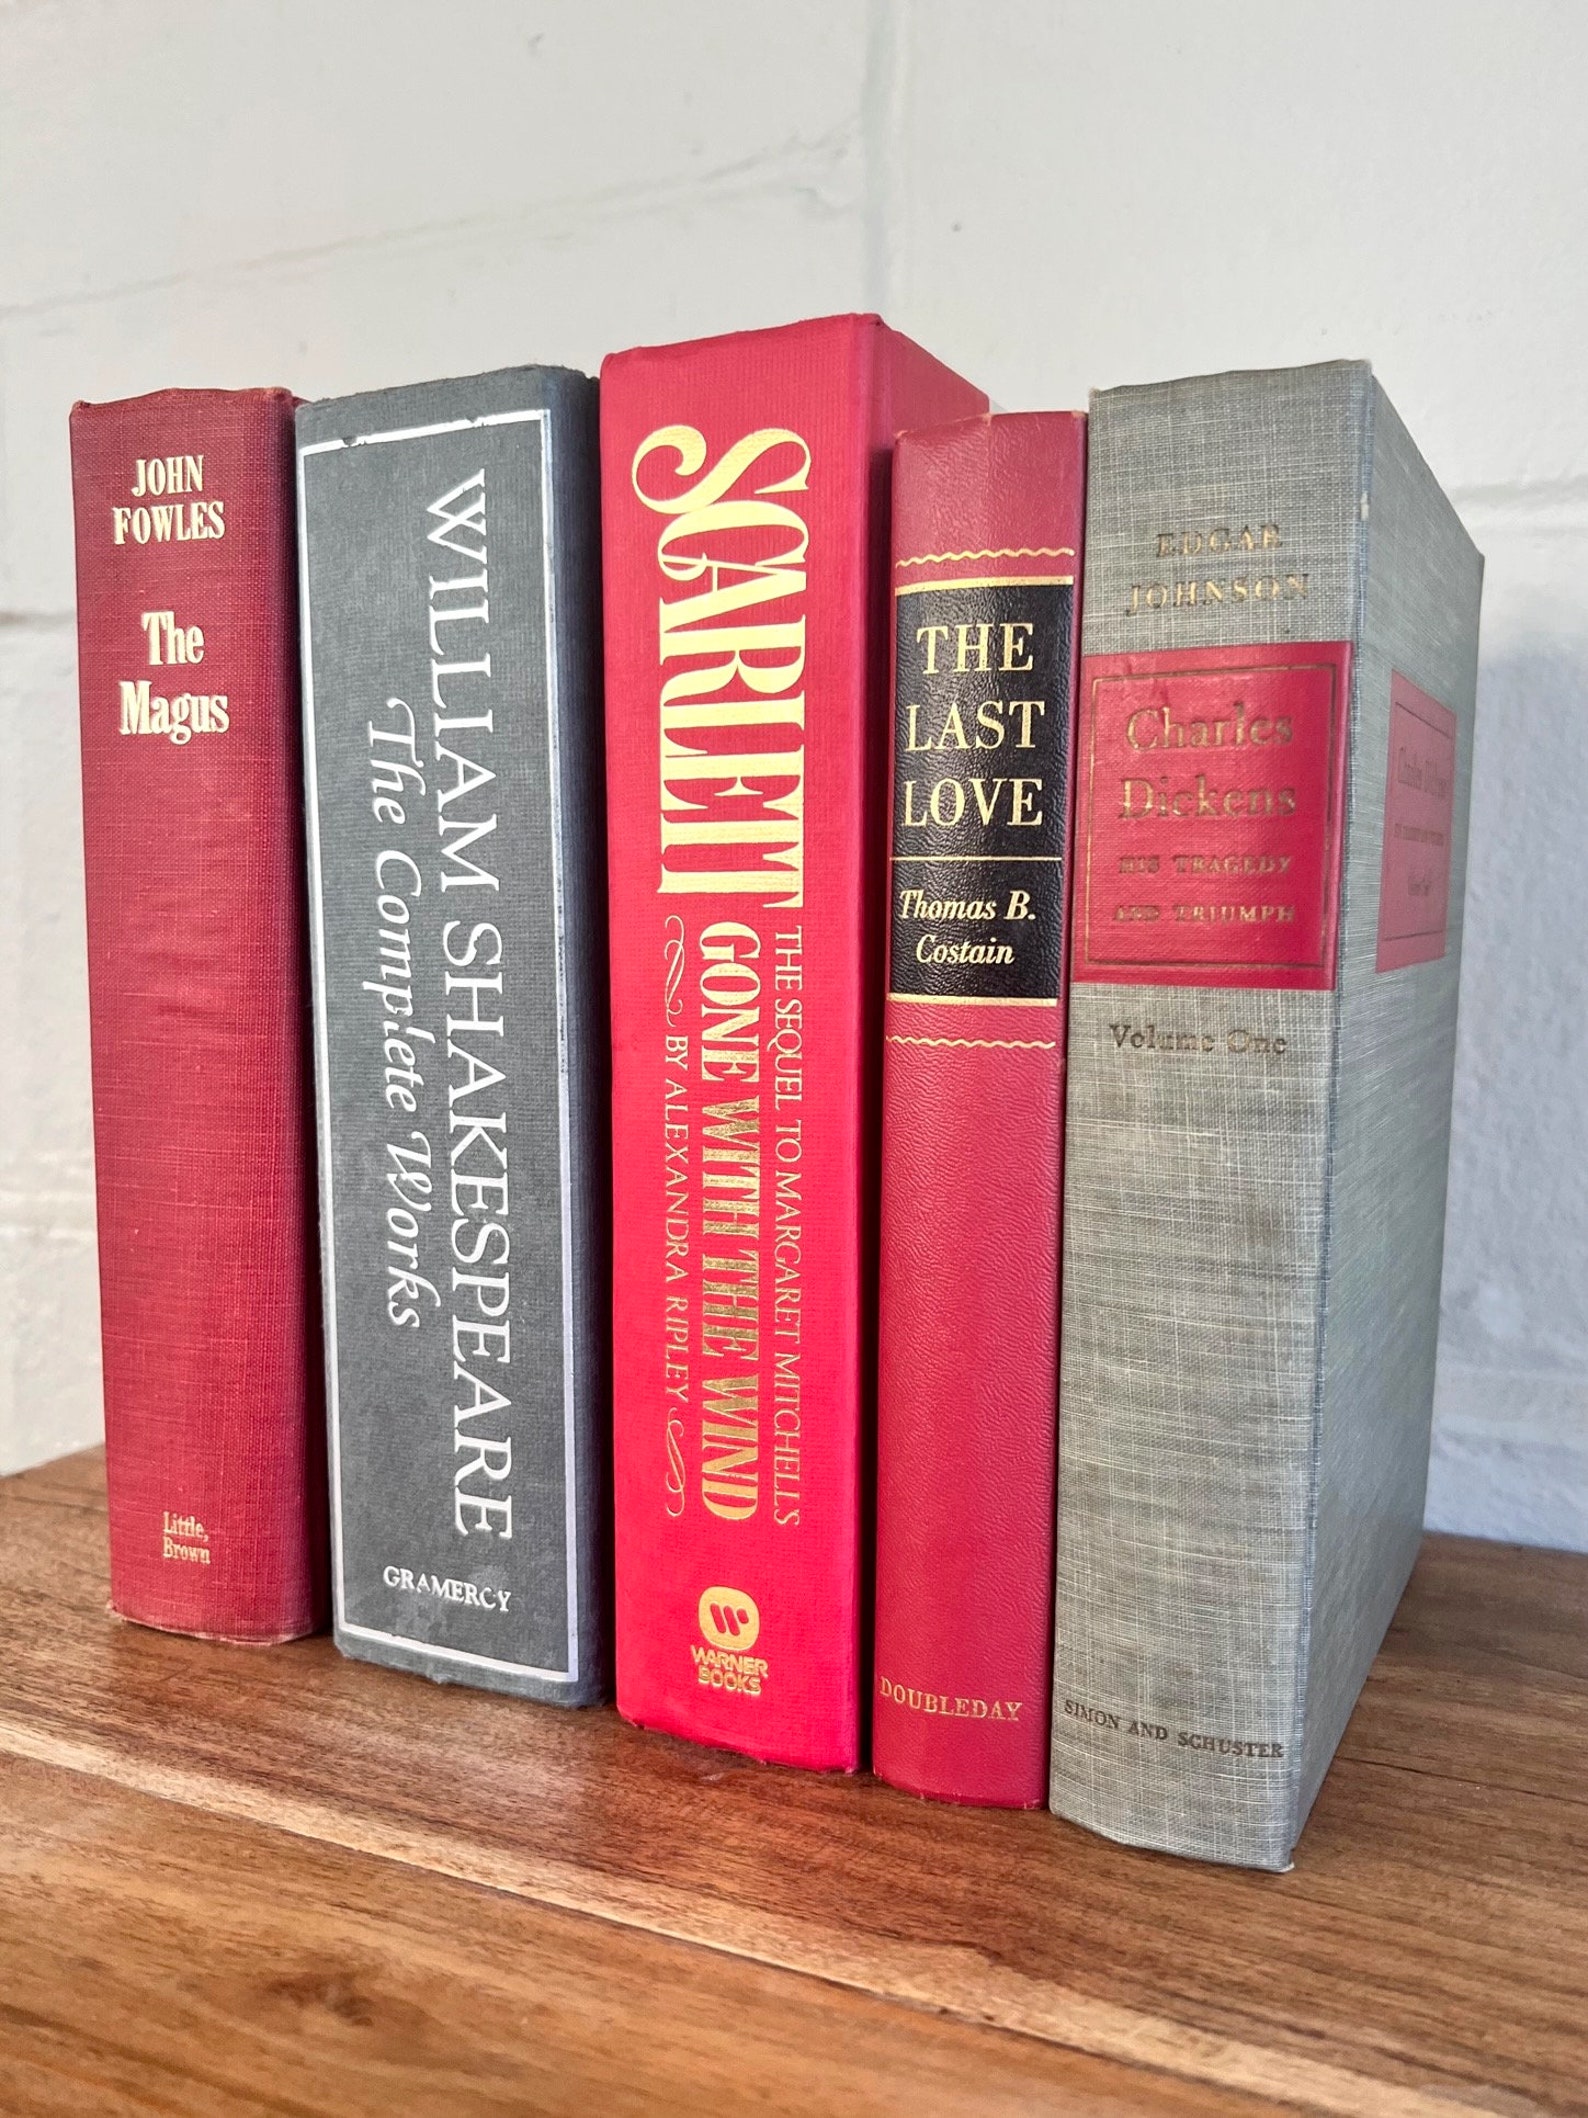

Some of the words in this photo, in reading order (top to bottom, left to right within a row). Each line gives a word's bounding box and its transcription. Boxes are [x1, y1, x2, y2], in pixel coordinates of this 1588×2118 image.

[131, 454, 205, 497] JOHN
[112, 500, 226, 545] FOWLES
[1155, 523, 1283, 558] EDGAR
[1125, 573, 1310, 617] JOHNSON
[141, 610, 206, 666] The
[916, 622, 1035, 675] THE
[426, 467, 500, 893] WILLIAM
[631, 425, 811, 908] SCARLETT
[118, 679, 231, 746] Magus
[904, 700, 1046, 752] LAST
[1125, 701, 1293, 752] Charles
[366, 698, 427, 826] The
[904, 777, 1044, 828] LOVE
[1119, 773, 1297, 820] Dickens
[1171, 853, 1294, 875] TRAGEDY
[900, 889, 998, 922] Thomas
[1003, 890, 1038, 922] B.
[1171, 904, 1297, 923] TRIUMPH
[774, 925, 803, 991] THE
[915, 934, 1016, 967] Costain
[362, 849, 434, 1113] Complete
[699, 921, 761, 1084] GONE
[664, 1034, 689, 1071] BY
[766, 998, 803, 1111] SEQUEL
[1109, 1022, 1217, 1053] Volume
[1226, 1028, 1288, 1056] One
[774, 1118, 803, 1163] TO
[664, 1078, 690, 1283] ALEXANDRA
[701, 1095, 761, 1240] WITH
[385, 1131, 441, 1329] Works
[442, 919, 513, 1539] SHAKESPEARE
[772, 1170, 803, 1345] MARGARET
[701, 1248, 761, 1361] THE
[664, 1295, 690, 1403] RIPLEY
[701, 1373, 760, 1521] WIND
[162, 1536, 211, 1565] Brown
[163, 1511, 209, 1543] Little,
[382, 1565, 512, 1612] GRAMERCY
[690, 1645, 768, 1678] WARNER
[697, 1664, 763, 1697] BOOKS
[879, 1675, 1024, 1722] DOUBLEDAY
[1064, 1699, 1122, 1730] SIMON
[1128, 1721, 1170, 1741] AND
[1177, 1731, 1285, 1758] SCHUSTER
